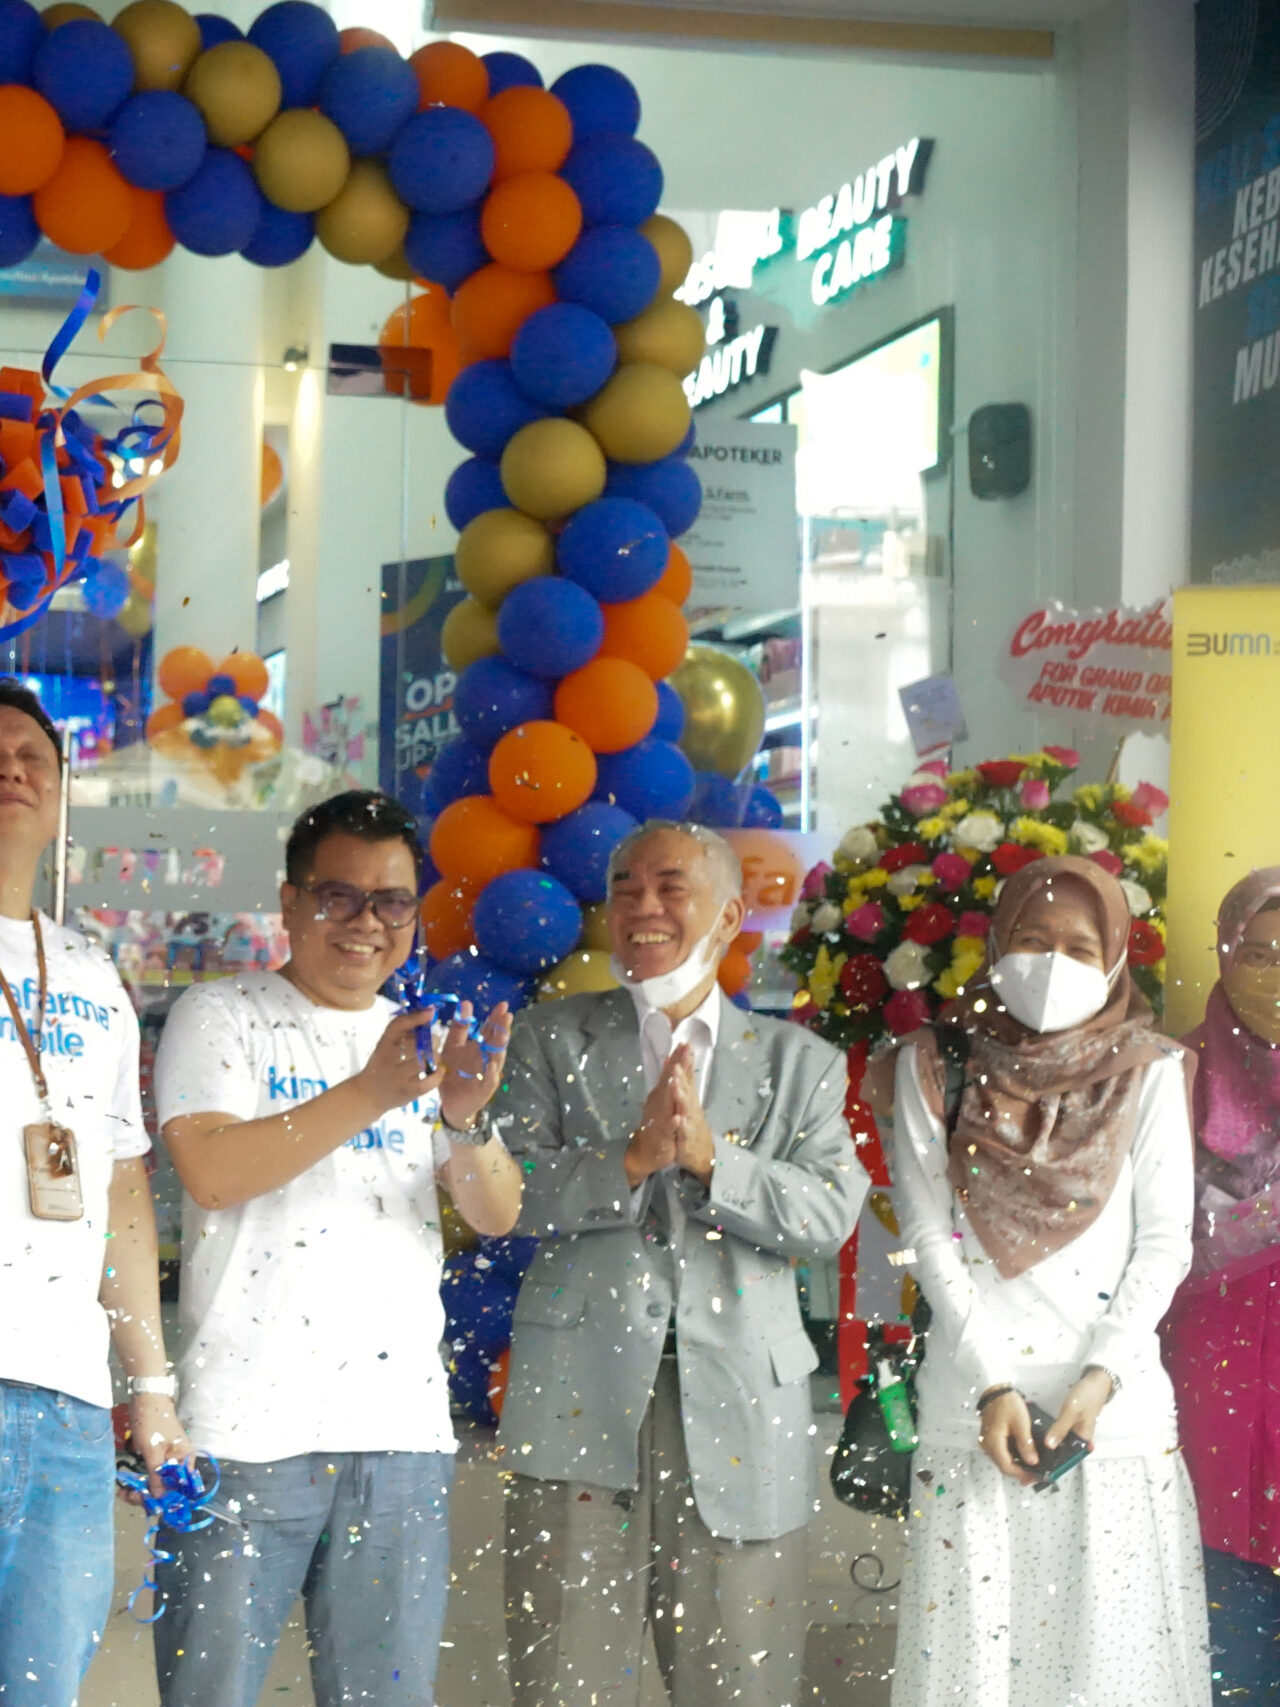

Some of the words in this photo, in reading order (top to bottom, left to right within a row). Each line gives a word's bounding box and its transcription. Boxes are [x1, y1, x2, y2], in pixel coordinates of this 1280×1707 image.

[796, 137, 919, 261] BEAUTY
[811, 214, 893, 305] CARE
[1199, 222, 1280, 308] KESEH
[682, 323, 765, 408] EAUTY
